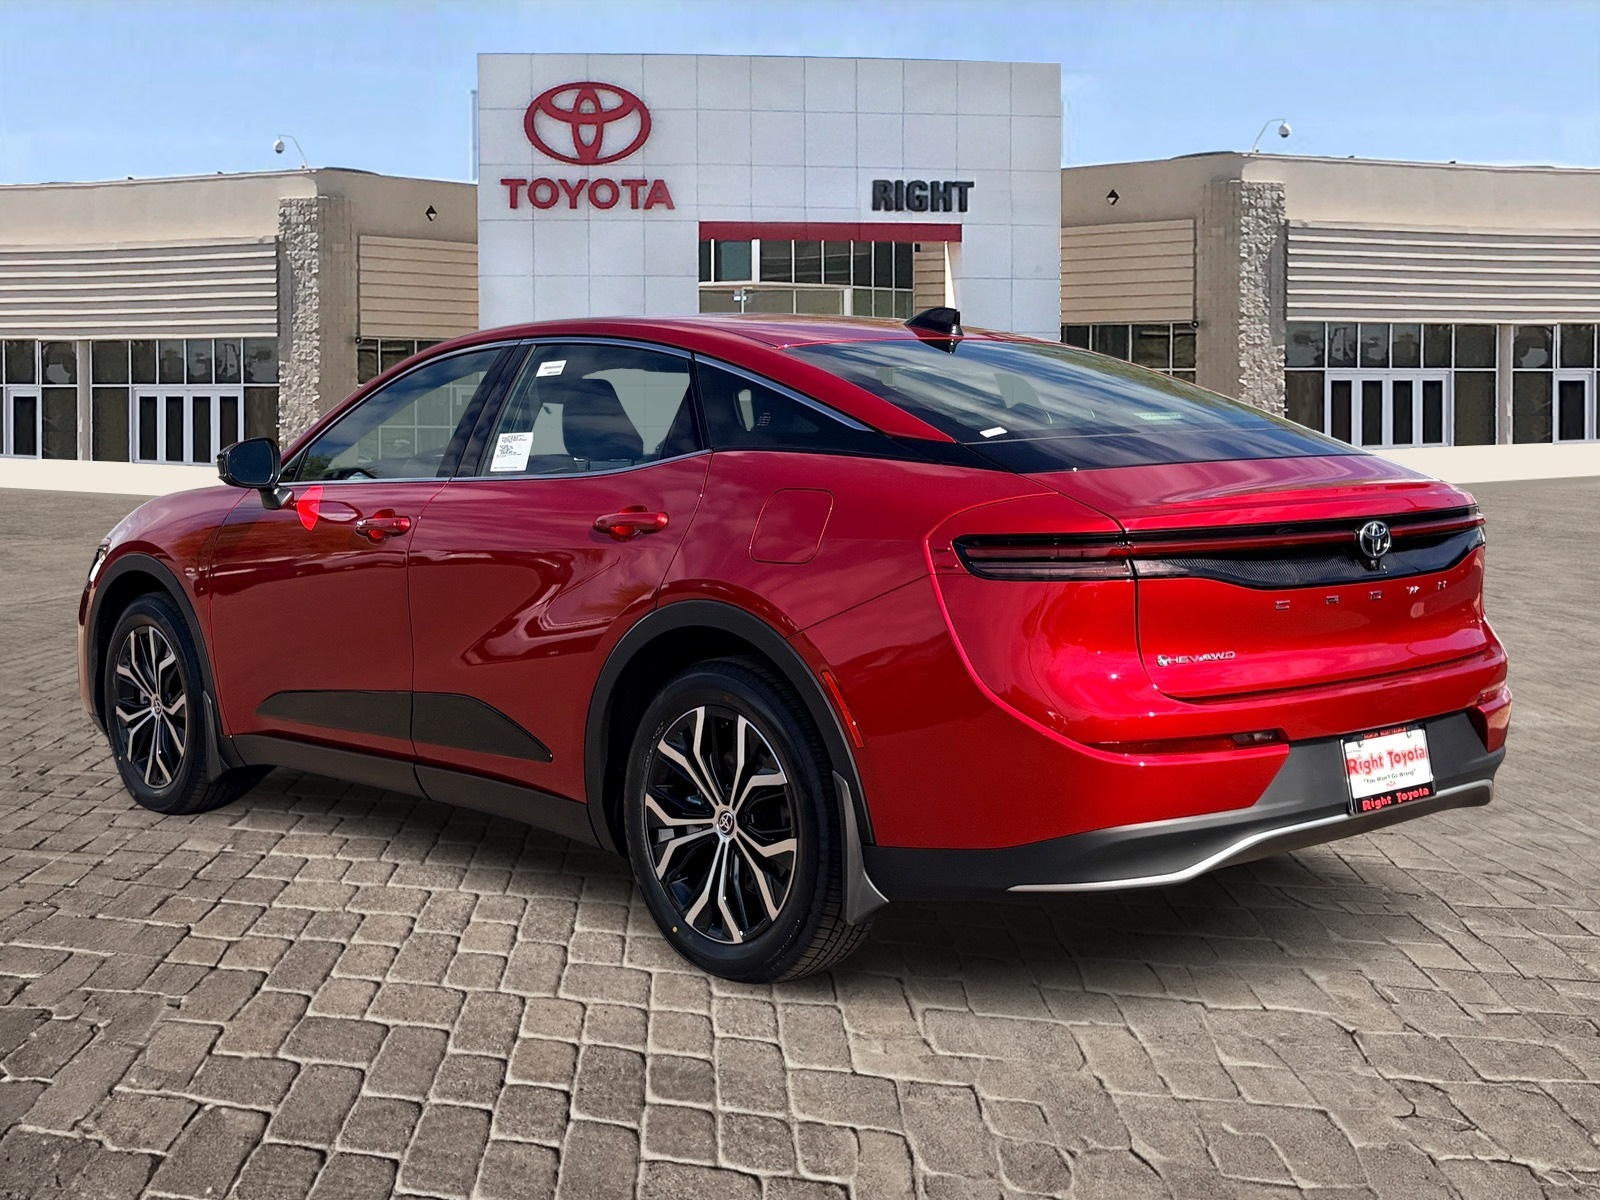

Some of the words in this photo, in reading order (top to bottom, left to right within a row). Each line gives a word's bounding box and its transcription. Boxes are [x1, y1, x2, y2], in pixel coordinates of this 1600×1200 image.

[500, 178, 675, 210] TOYOTA
[872, 180, 975, 212] RIGHT
[1347, 752, 1385, 775] Right
[1387, 745, 1426, 769] Toyota
[1362, 795, 1392, 811] Right
[1396, 787, 1430, 803] Toyota
